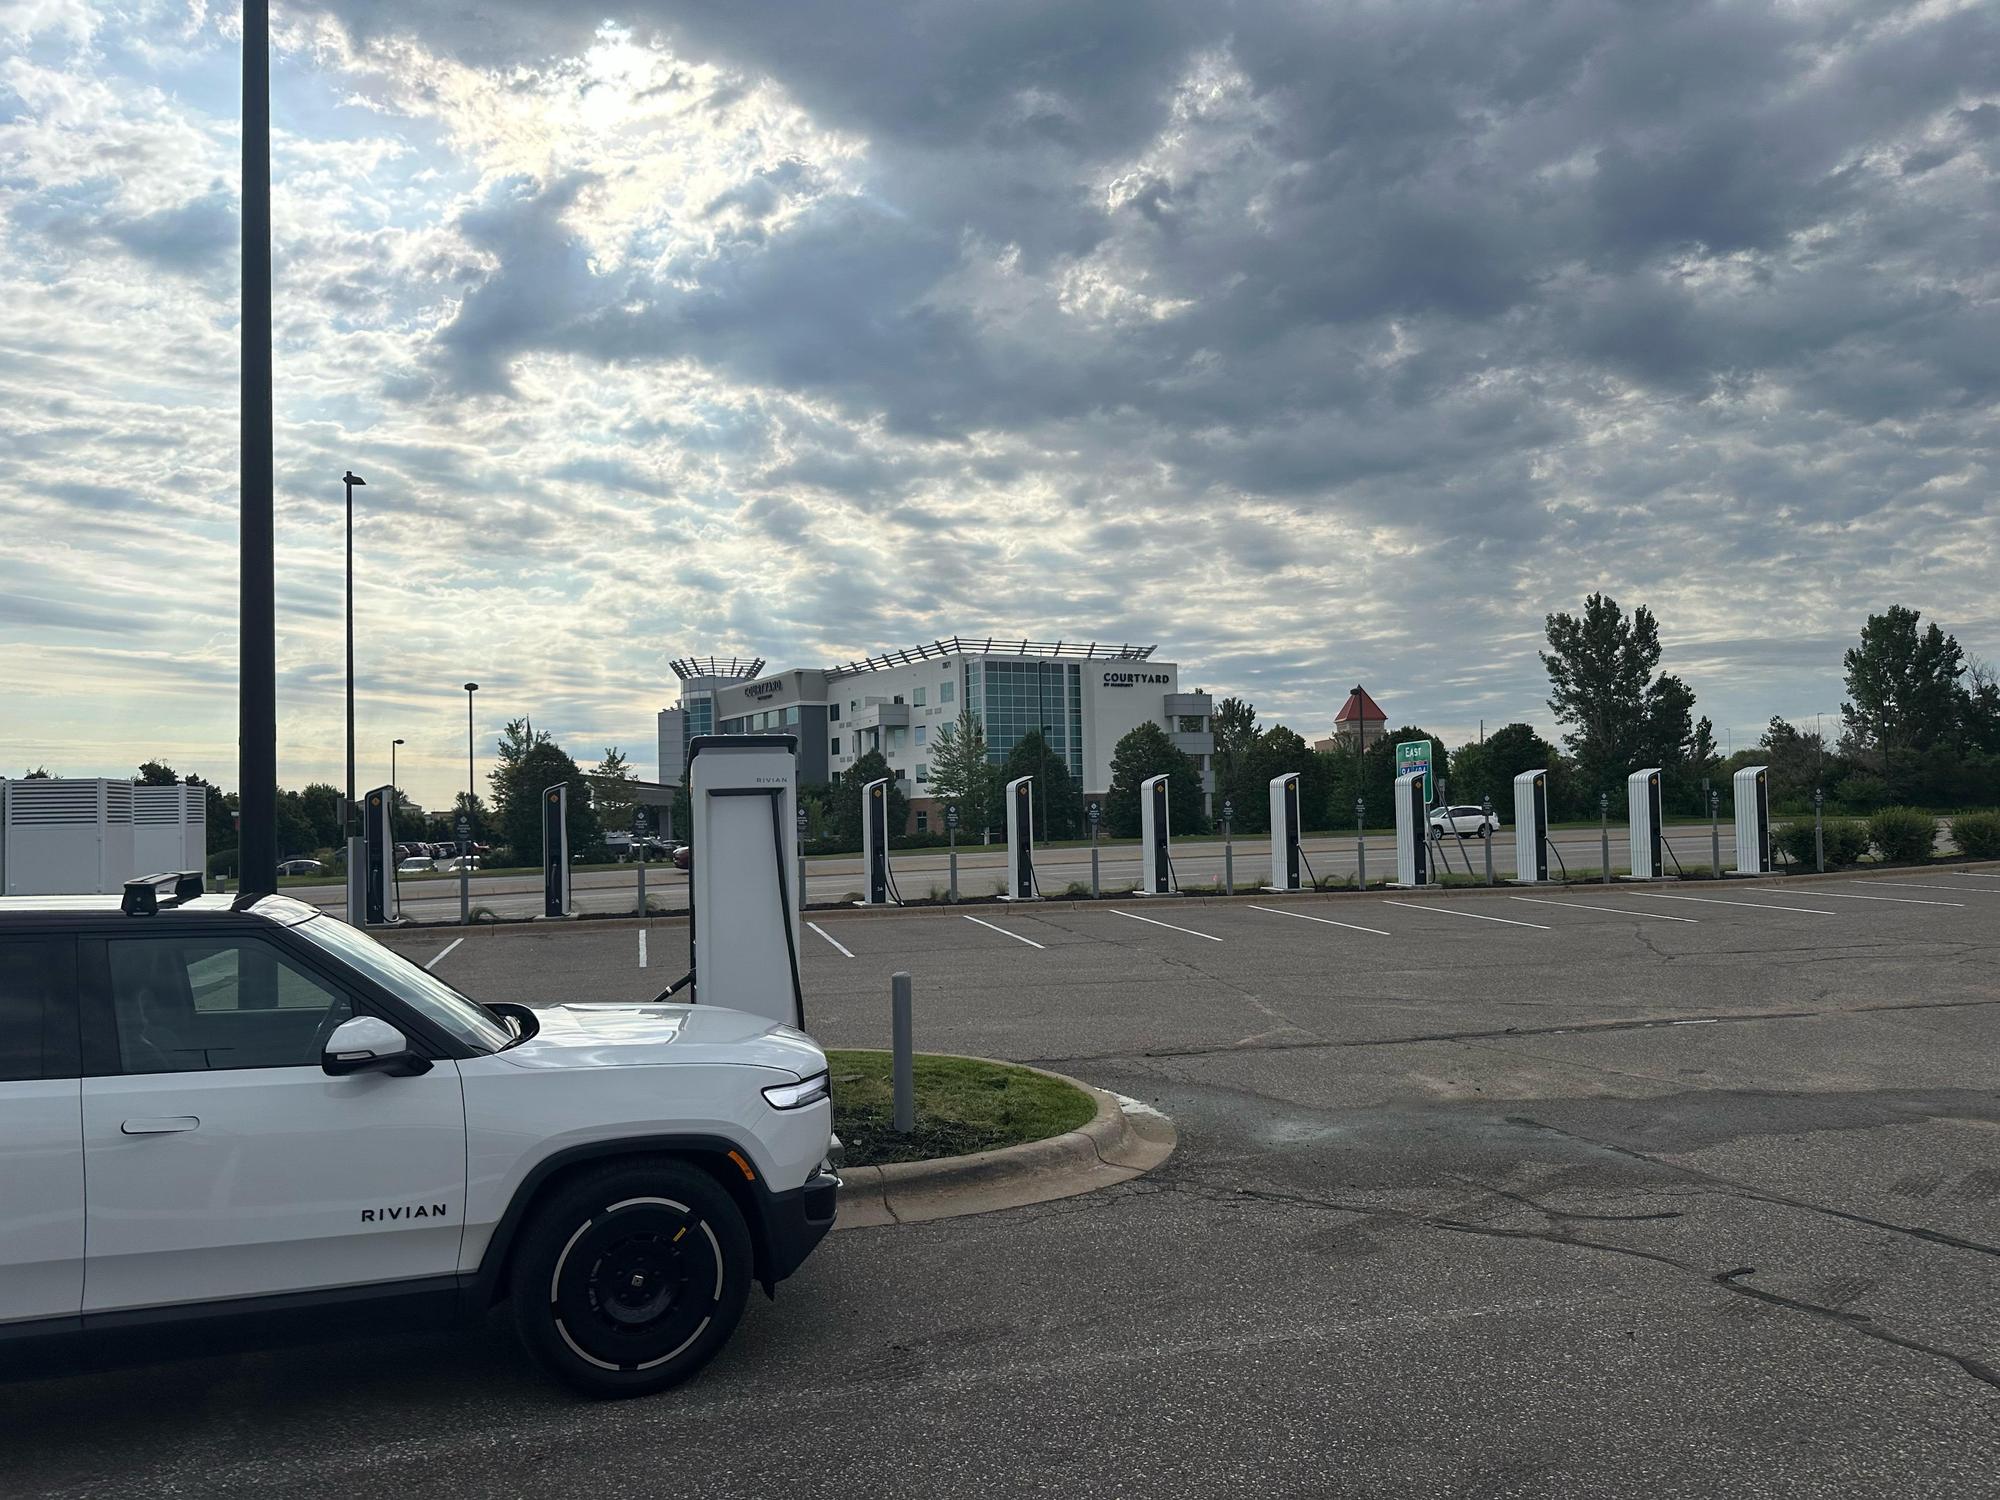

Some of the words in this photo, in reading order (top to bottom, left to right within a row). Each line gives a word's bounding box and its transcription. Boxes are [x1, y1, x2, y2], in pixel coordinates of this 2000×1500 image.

[1103, 672, 1170, 684] COURTYARD
[1405, 747, 1422, 758] EAST
[361, 1203, 447, 1223] RIVIAN
